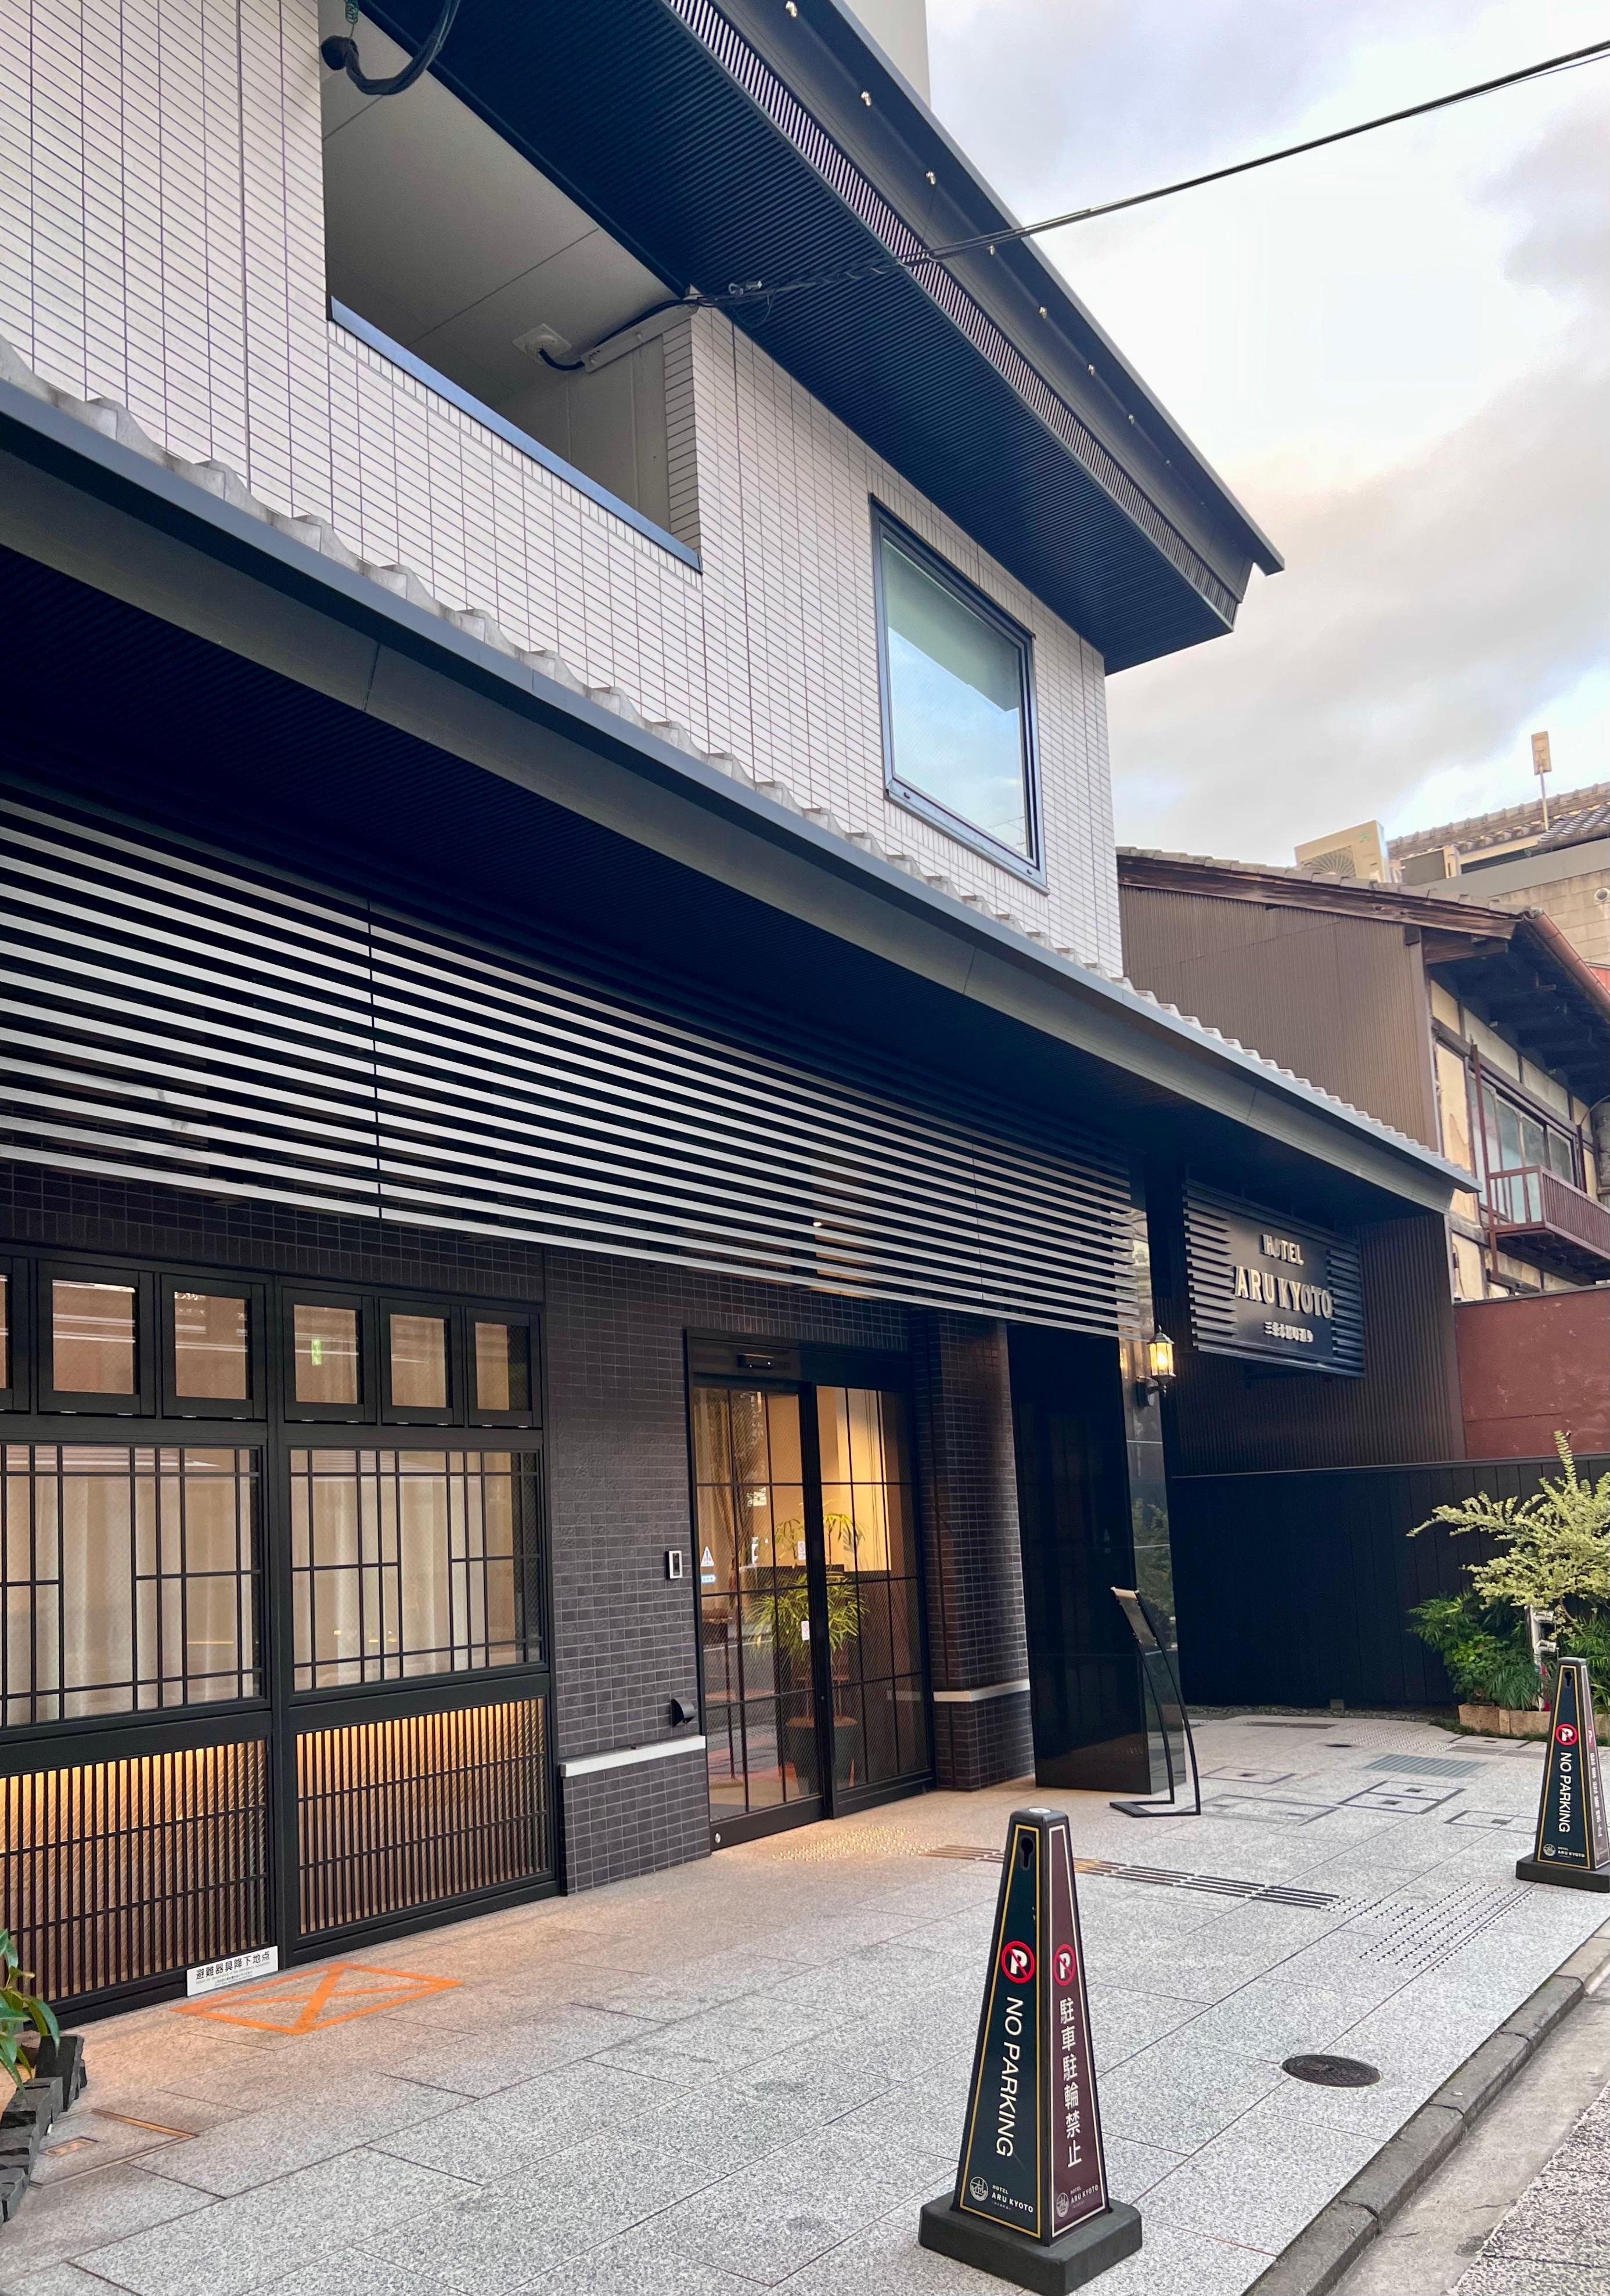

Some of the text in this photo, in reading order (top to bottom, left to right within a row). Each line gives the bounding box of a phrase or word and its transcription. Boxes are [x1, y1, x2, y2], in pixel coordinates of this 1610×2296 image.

[1262, 1234, 1304, 1266] HOTEL
[1234, 1266, 1333, 1319] ARU KYOTO
[1558, 1752, 1572, 1832] NO PARKING
[195, 1951, 270, 1980] 避難器具降下地点
[996, 1996, 1024, 2157] NO PARKING
[1059, 1997, 1082, 2168] 駐車駐輪禁止
[991, 2192, 1007, 2203] ARU
[1008, 2198, 1033, 2213] KYOTO
[992, 2185, 1008, 2194] HOTEL
[1071, 2184, 1098, 2204] ARU KYOTO
